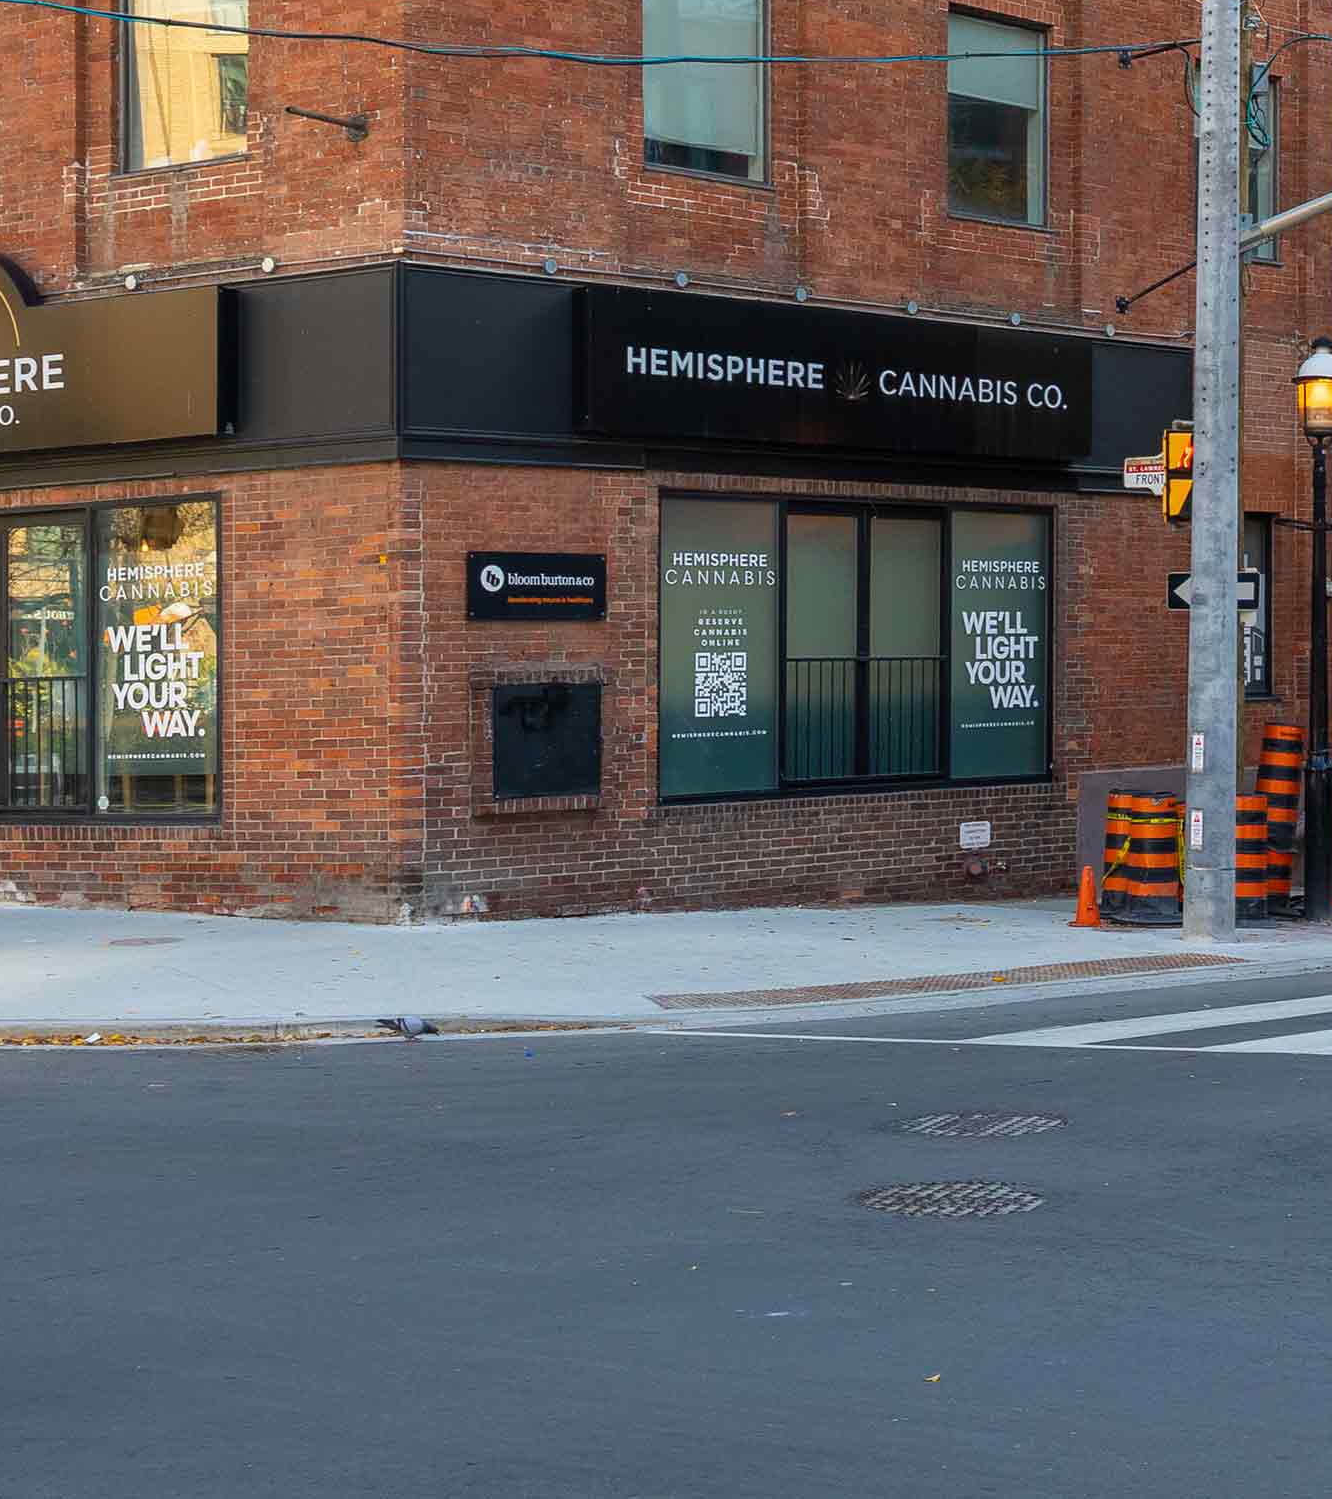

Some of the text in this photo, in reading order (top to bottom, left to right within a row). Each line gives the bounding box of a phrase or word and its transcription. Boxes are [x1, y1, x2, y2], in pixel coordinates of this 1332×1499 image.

[626, 345, 1068, 410] HEMISPHERE CANNABIS CO.
[1135, 473, 1164, 485] FRONT
[107, 562, 205, 582] HEMISPHERE
[673, 552, 768, 568] HEMISPHERE
[962, 559, 1039, 573] HEMISPHERE
[665, 568, 776, 586] CANNABIS
[955, 574, 1046, 590] CANNABIS
[99, 581, 213, 602] CANNABIS
[693, 628, 748, 636] CANNABIS
[962, 610, 1028, 635] WE'LL
[108, 622, 189, 653] WE'LL
[975, 636, 1039, 660] LIGHT
[123, 651, 204, 681] LIGHT
[965, 660, 1025, 685] YOUR
[111, 681, 188, 710] YOUR
[989, 684, 1039, 709] WAY.
[141, 709, 206, 738] WAY.
